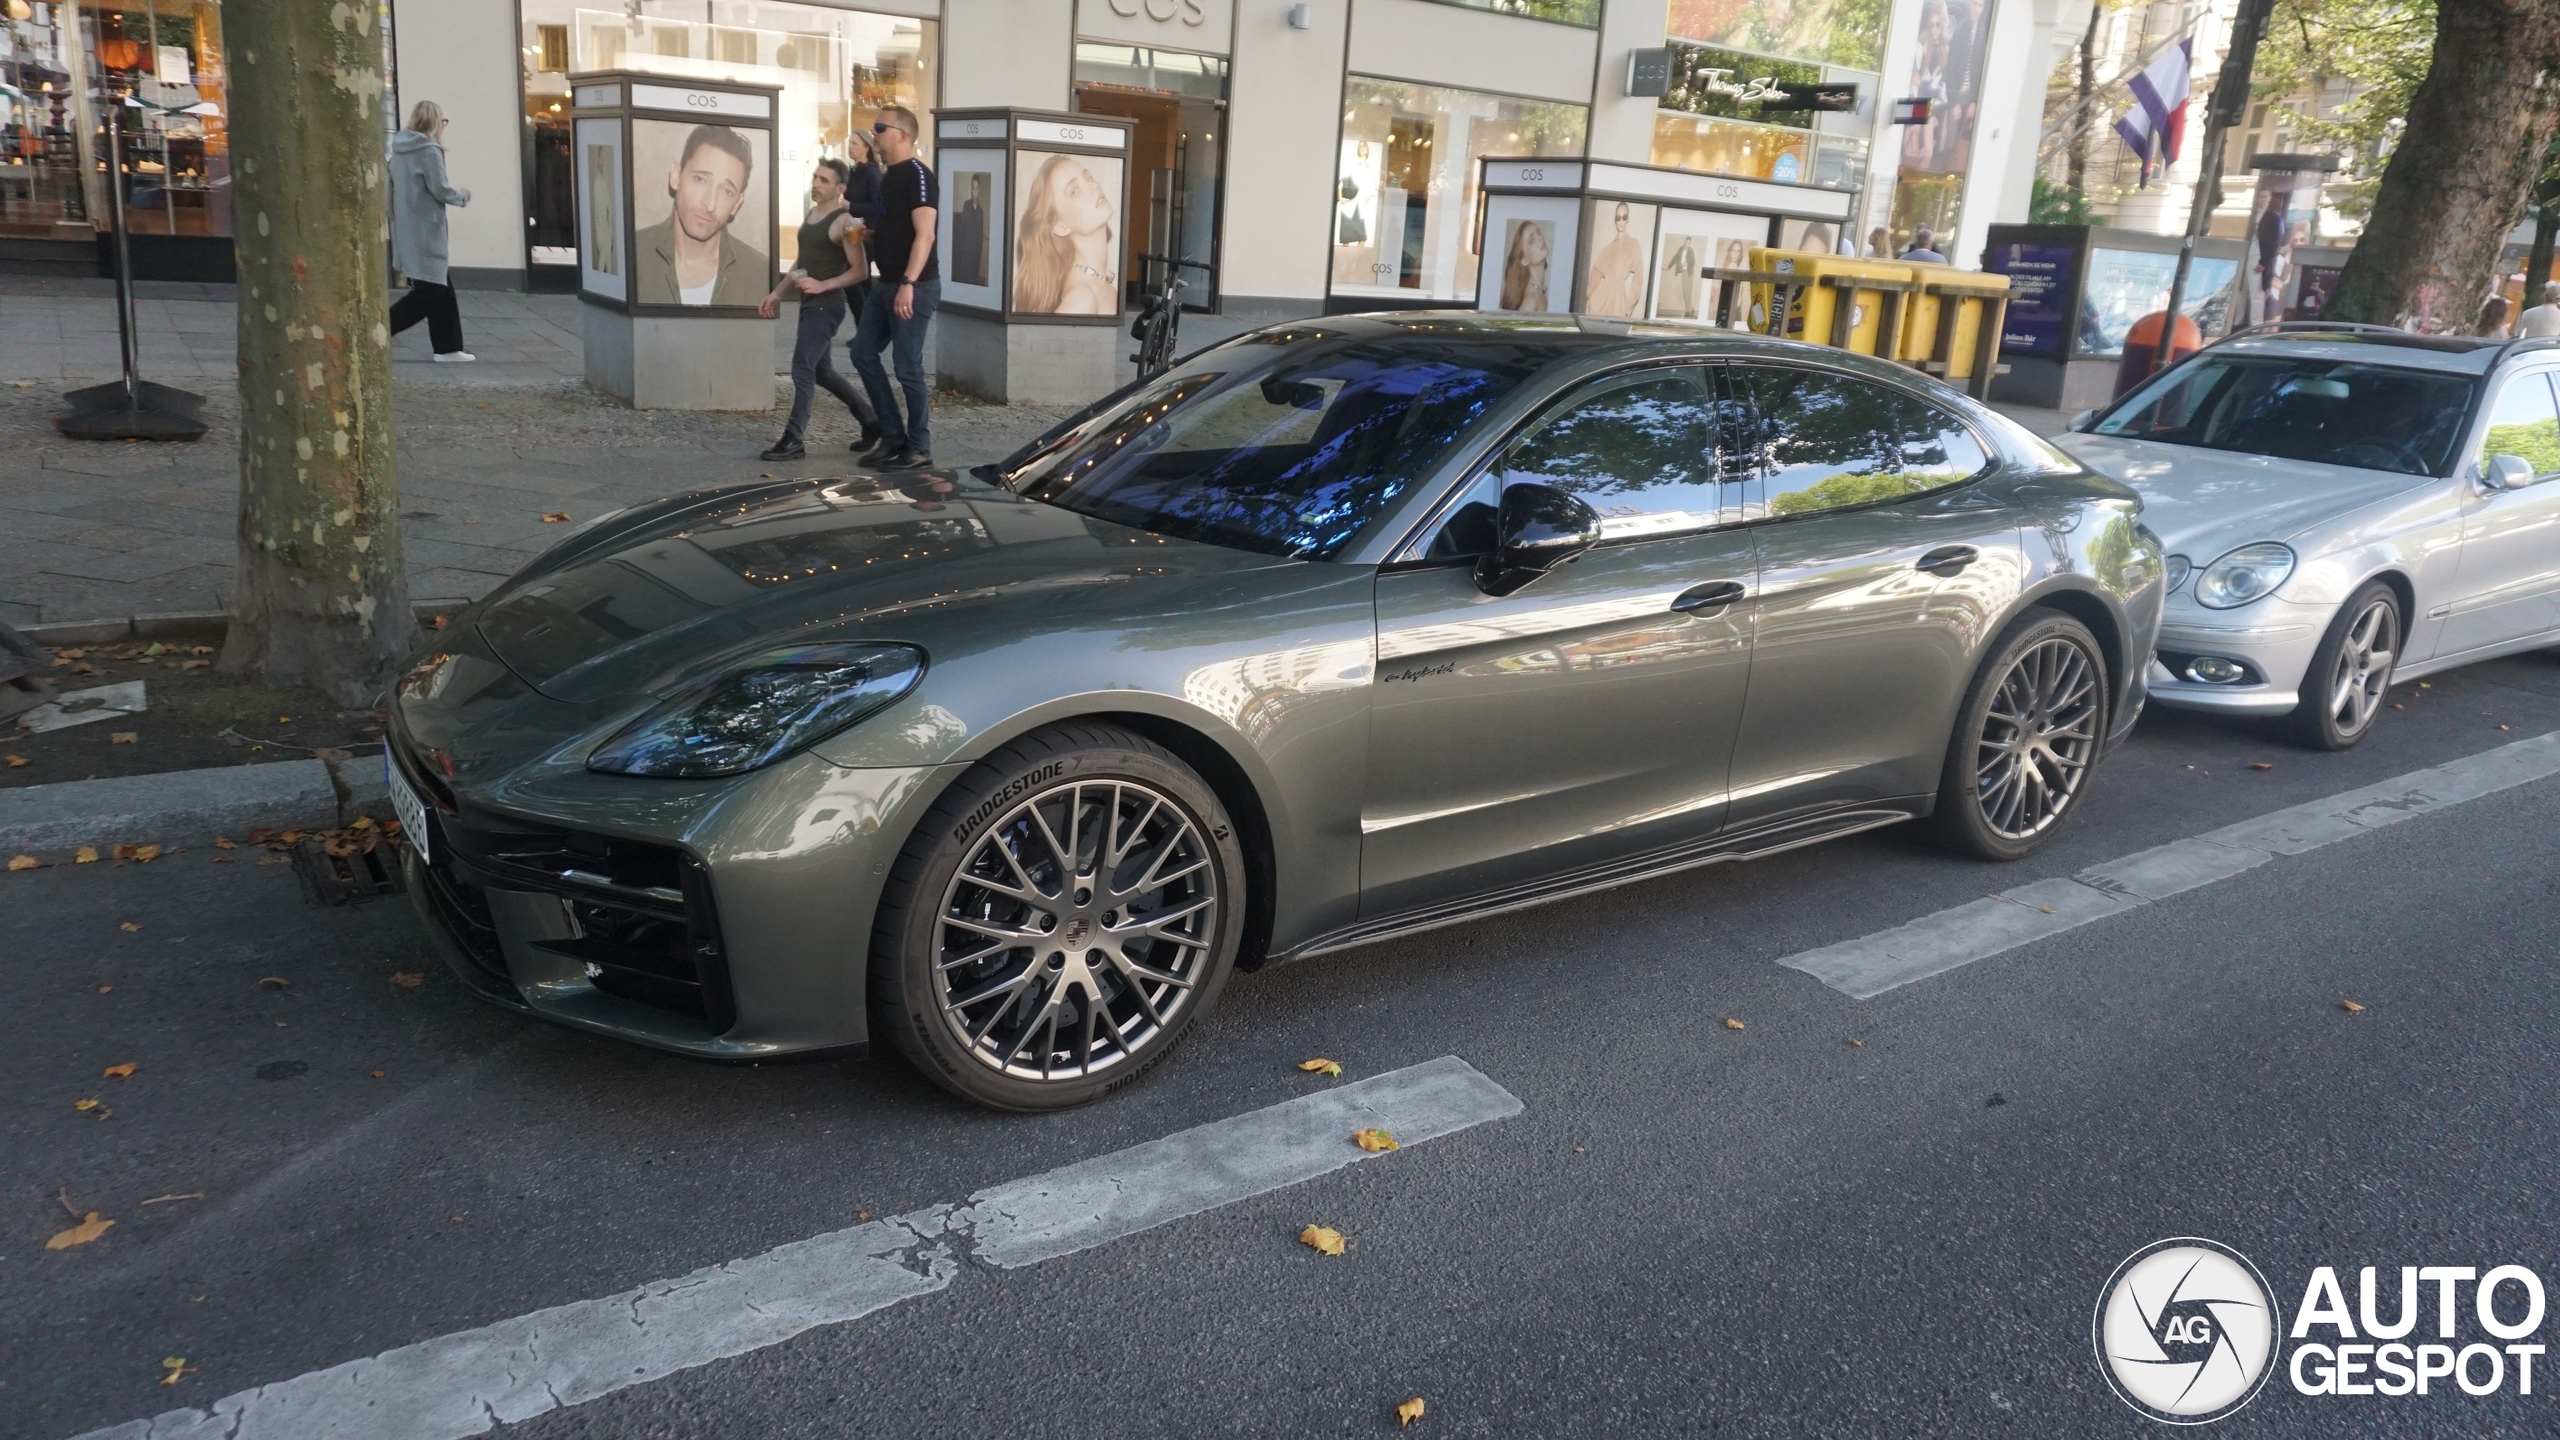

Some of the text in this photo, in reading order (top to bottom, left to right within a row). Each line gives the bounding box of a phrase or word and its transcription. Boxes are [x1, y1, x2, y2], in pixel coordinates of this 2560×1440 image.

[1697, 67, 1791, 100] Thomas Sabo
[687, 94, 718, 108] COS
[966, 123, 979, 135] COS
[1059, 127, 1085, 141] COS
[780, 150, 798, 162] LE
[1521, 168, 1544, 182] COS
[1775, 165, 1798, 179] -20%
[1717, 185, 1738, 198] COS
[1371, 262, 1393, 275] COS
[2005, 333, 2037, 342] Julius Bär
[953, 761, 1063, 846] BRIDGESTONE
[913, 1013, 958, 1076] POTENZA
[1104, 1017, 1199, 1097] BRIDGESTONE
